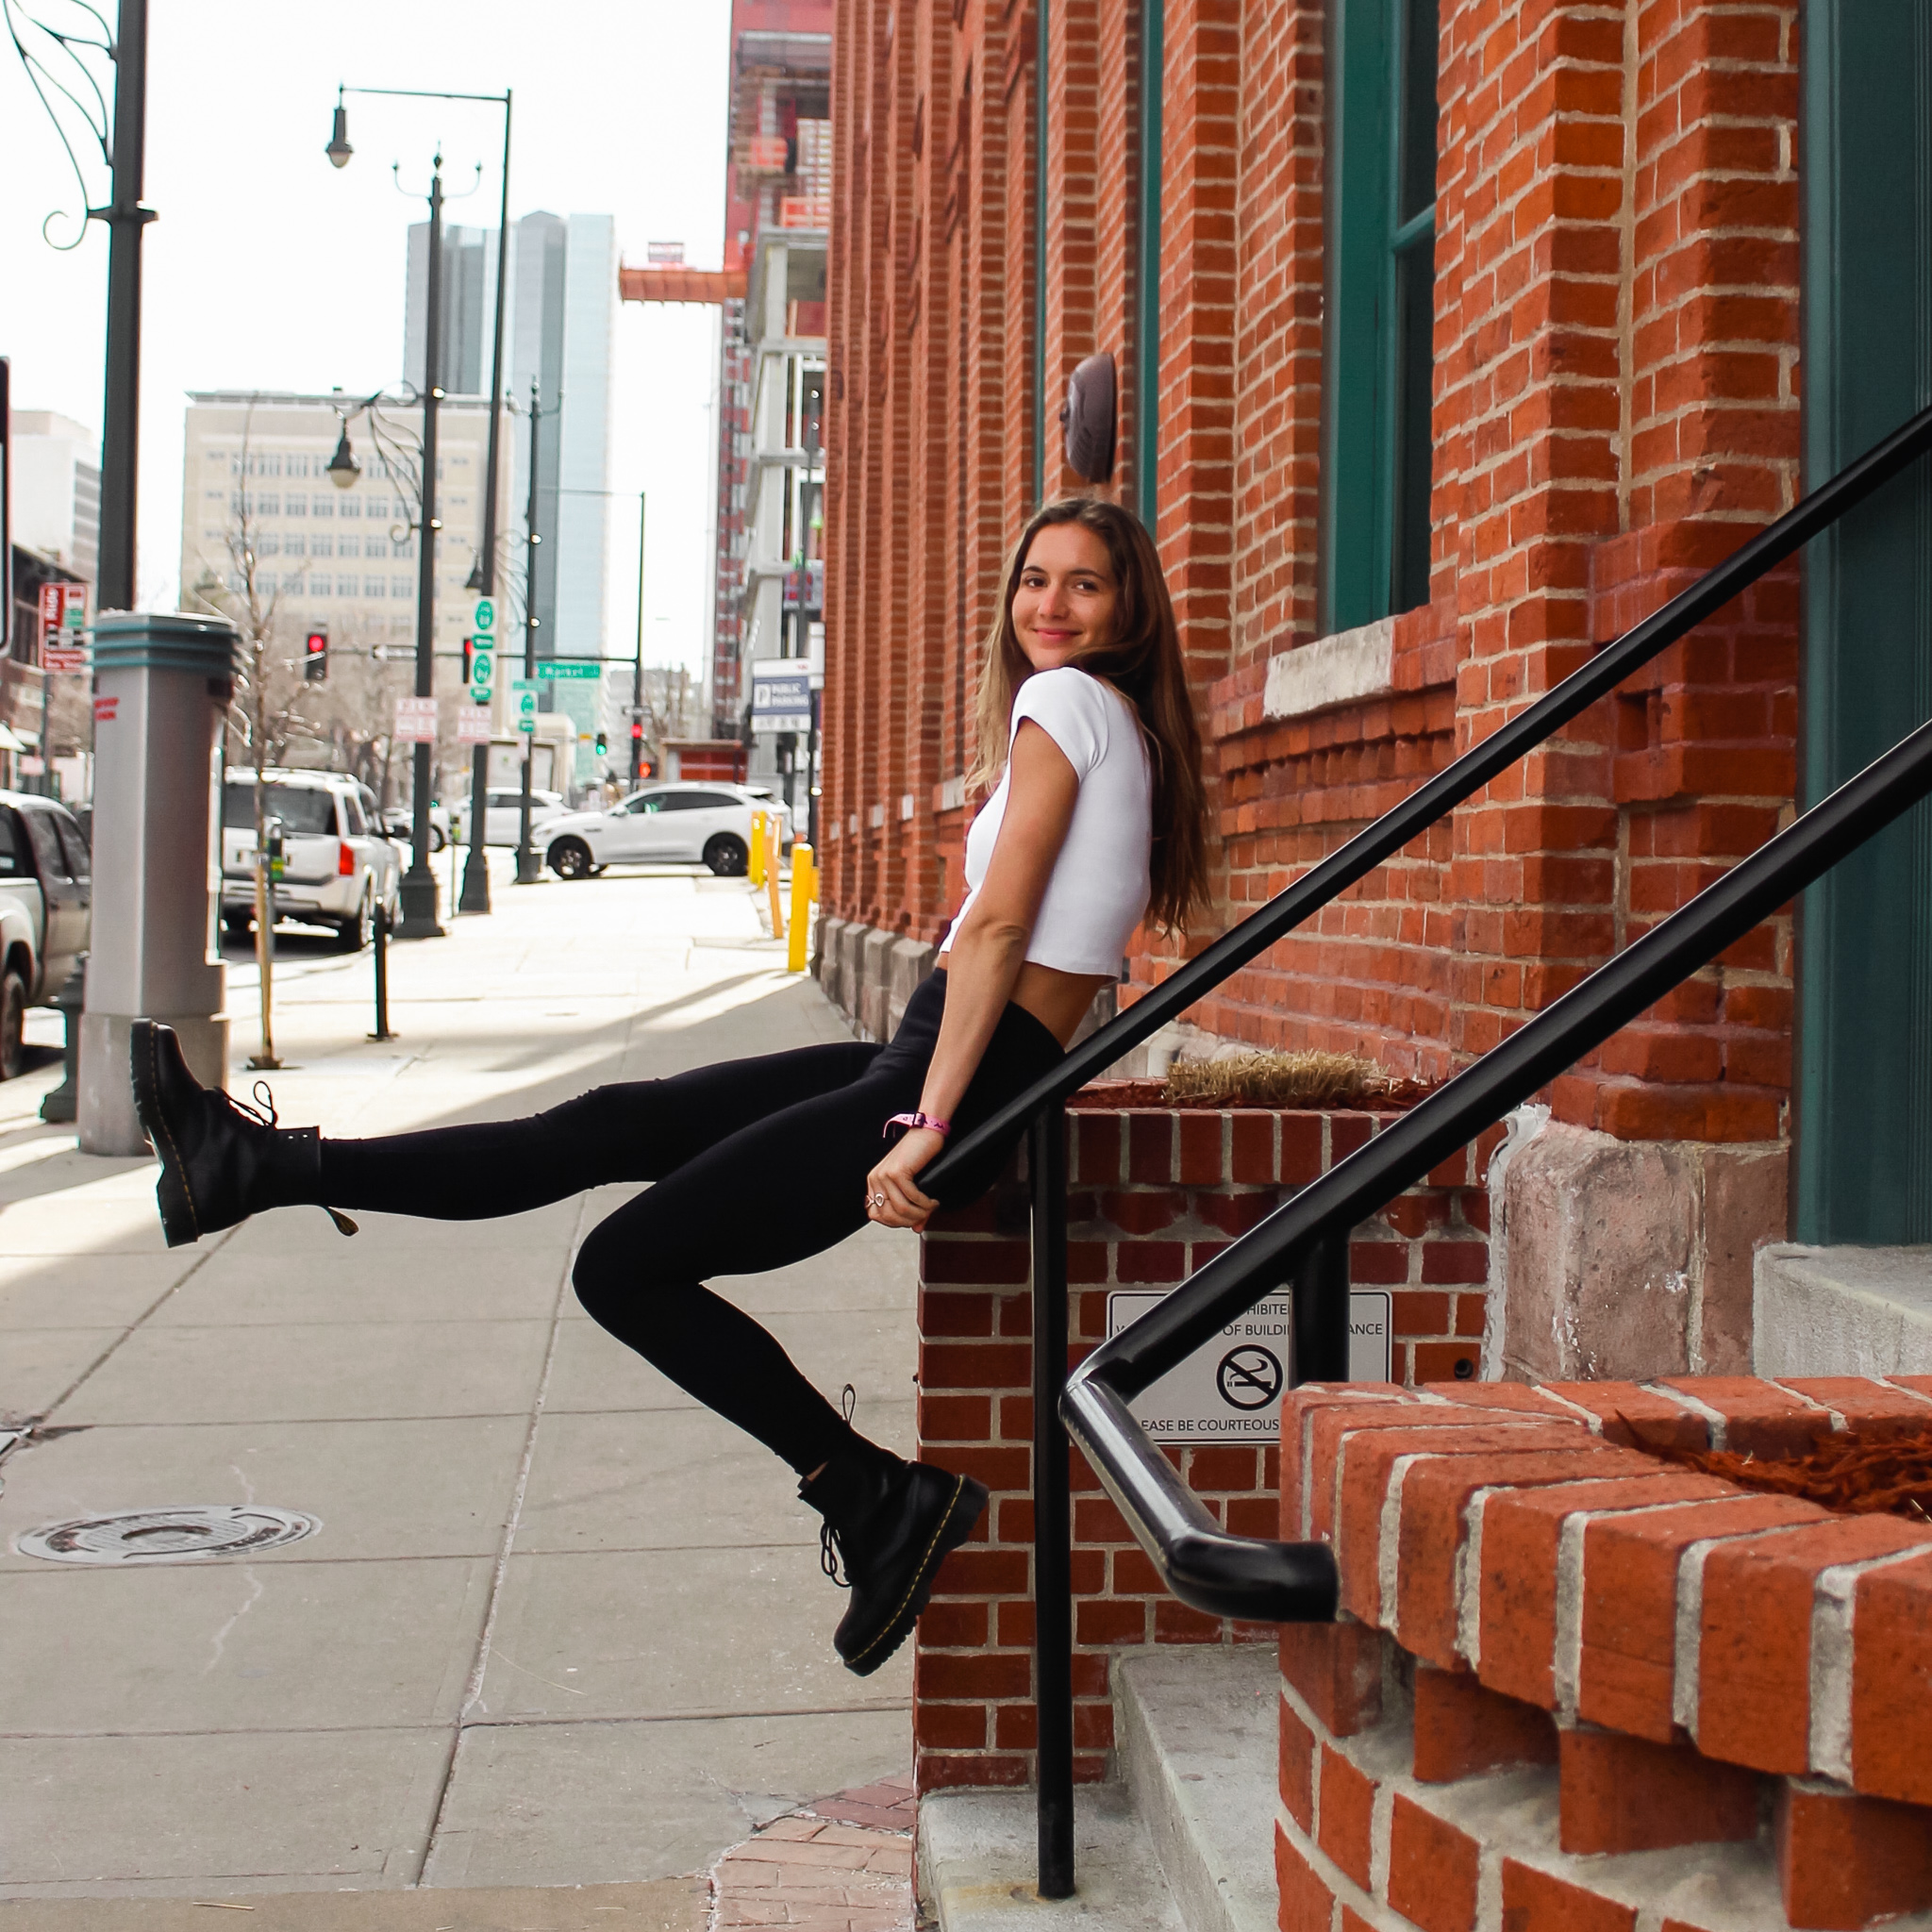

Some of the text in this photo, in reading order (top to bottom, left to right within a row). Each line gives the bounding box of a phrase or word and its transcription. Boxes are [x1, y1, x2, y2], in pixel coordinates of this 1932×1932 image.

[1246, 1304, 1290, 1315] HIBITE
[1223, 1324, 1383, 1336] OF BUILDI ANCE
[1141, 1419, 1279, 1431] EASE BE COURTEOUS
